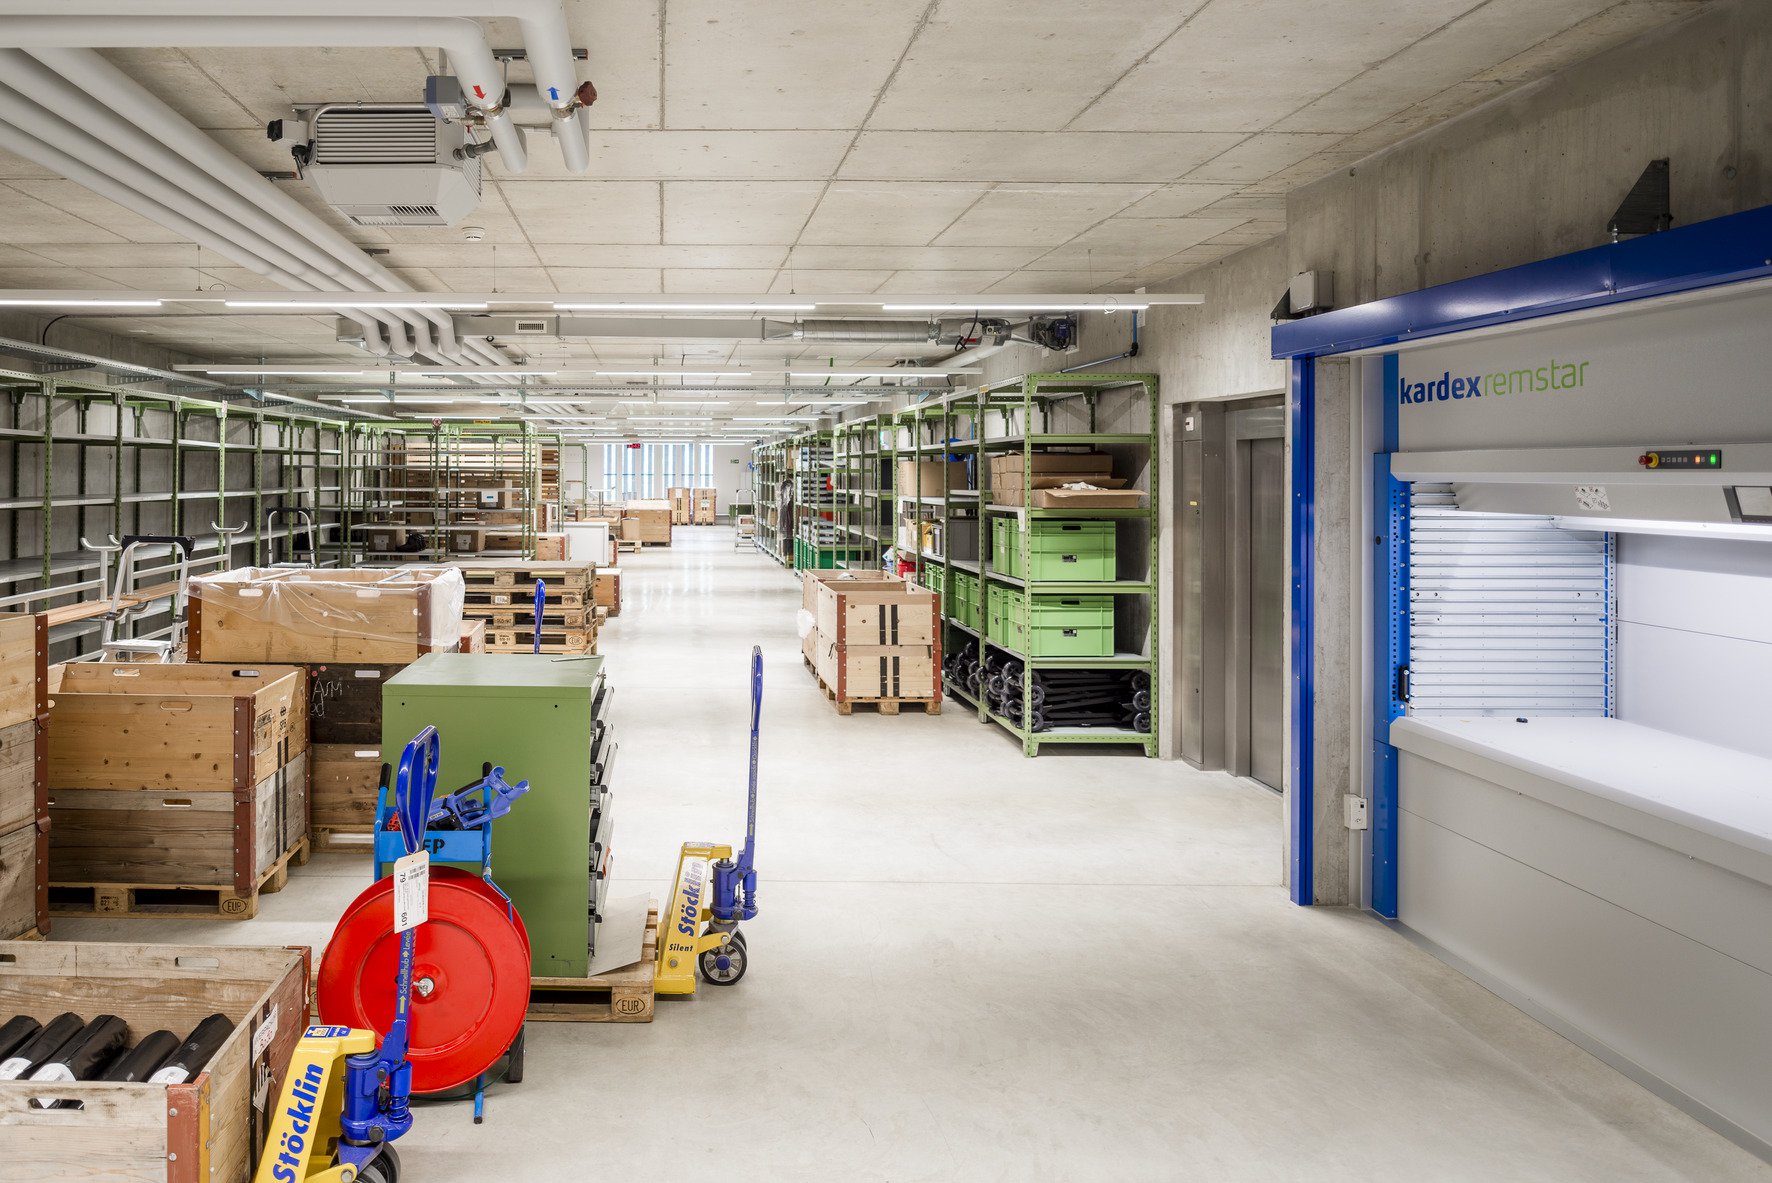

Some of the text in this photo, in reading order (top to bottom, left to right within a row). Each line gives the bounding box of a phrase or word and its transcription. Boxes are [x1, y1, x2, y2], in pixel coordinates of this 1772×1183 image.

[400, 872, 407, 884] 79
[678, 862, 703, 937] Stöcklin
[227, 901, 242, 912] EUR
[668, 943, 694, 953] Silent
[400, 958, 410, 994] Schnellhub
[621, 1000, 639, 1011] EUR
[273, 1063, 324, 1183] Stöcklin
